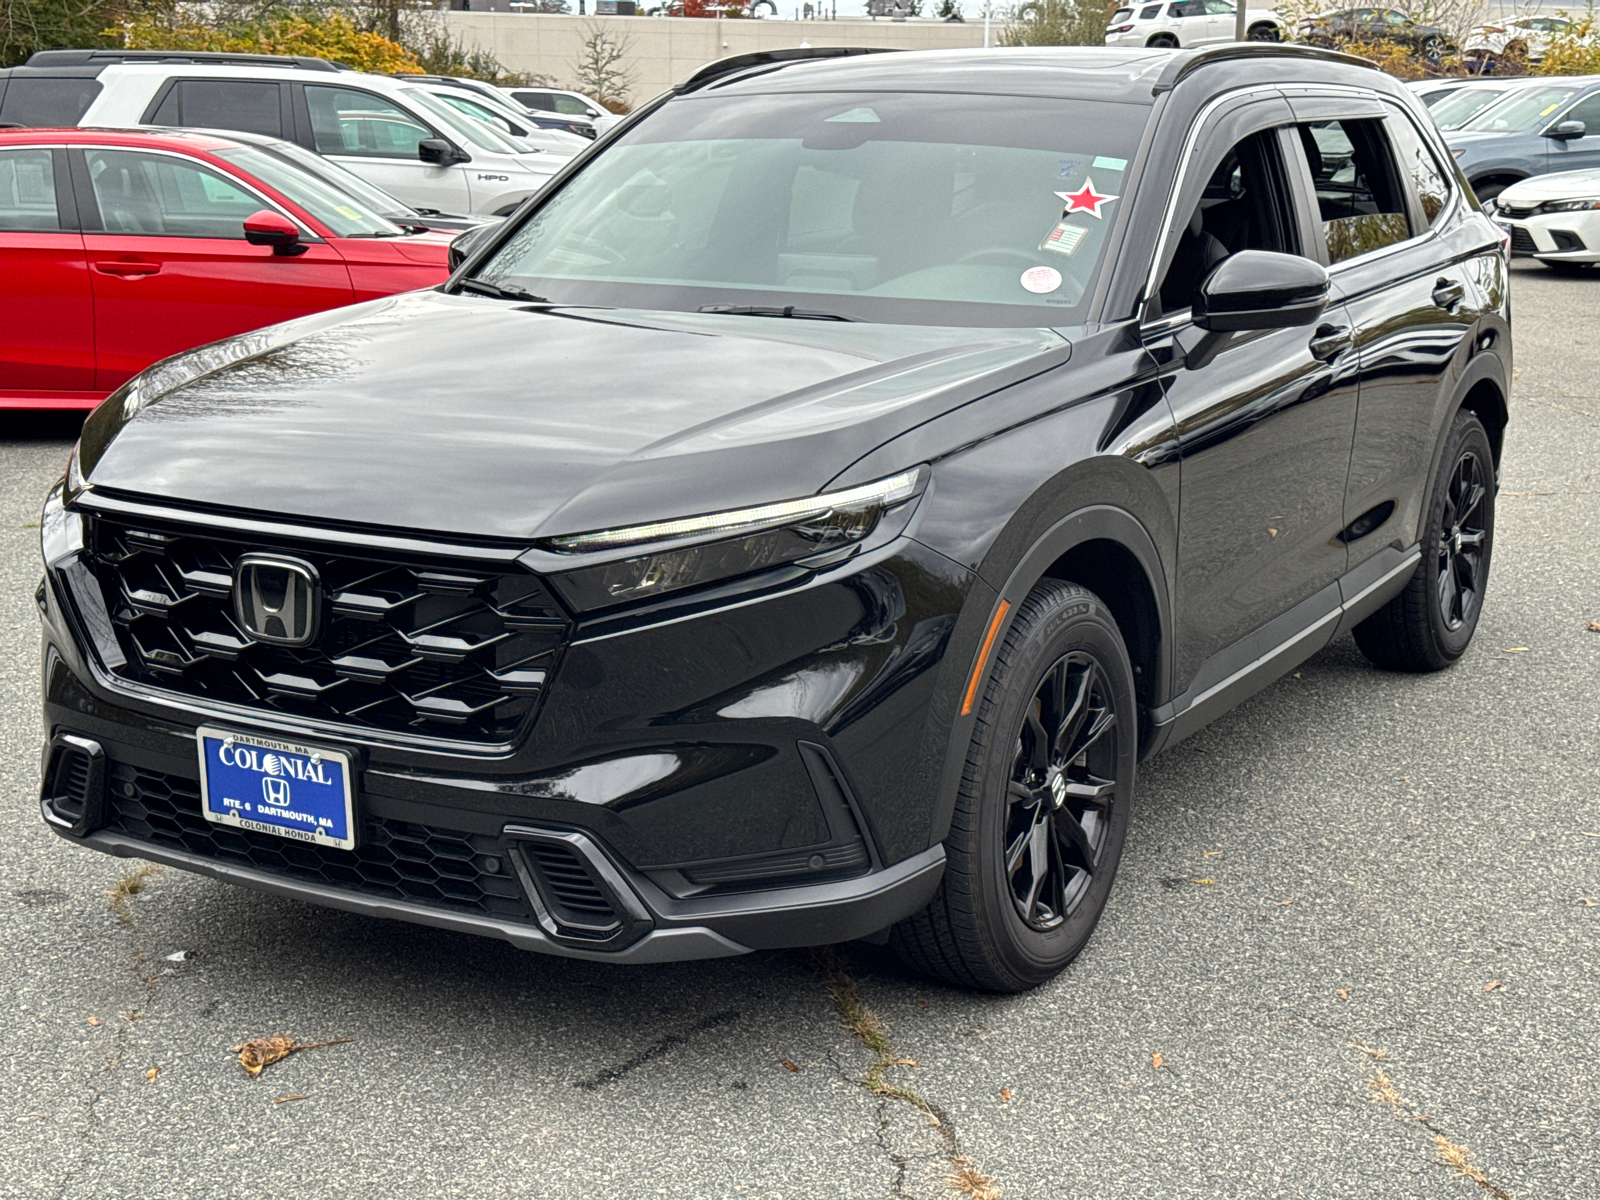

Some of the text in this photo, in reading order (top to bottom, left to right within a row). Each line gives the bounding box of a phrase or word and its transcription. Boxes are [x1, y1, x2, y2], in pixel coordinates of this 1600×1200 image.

[1062, 606, 1079, 619] 422
[294, 746, 310, 755] MA
[219, 745, 332, 785] COLONIAL
[223, 797, 334, 828] RTE. 6 DARTMOUTH, MA
[239, 819, 317, 842] COLONIAL HONDA
